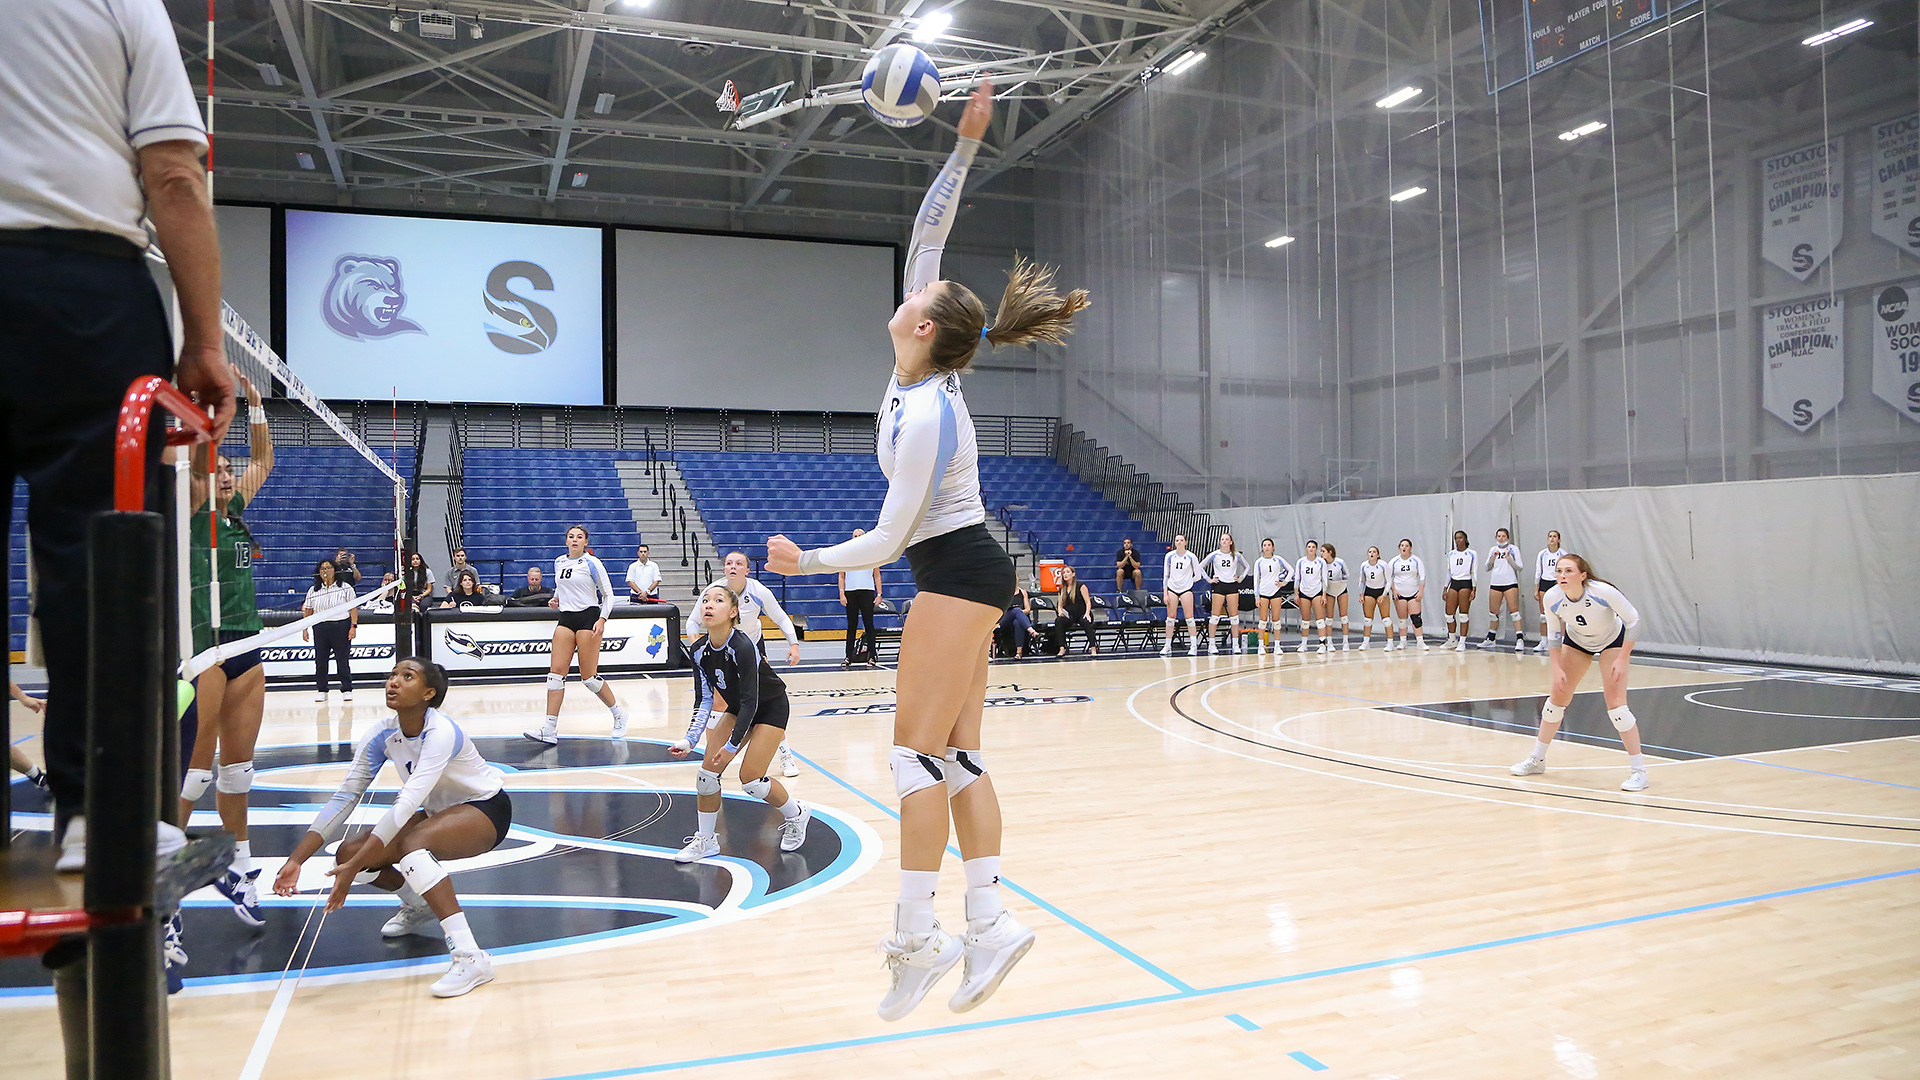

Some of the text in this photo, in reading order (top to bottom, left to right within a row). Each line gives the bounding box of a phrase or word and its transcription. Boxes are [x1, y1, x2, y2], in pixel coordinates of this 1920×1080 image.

[1567, 6, 1590, 23] PLAYER
[1630, 11, 1651, 27] SCORE
[1532, 25, 1550, 40] FOULS
[1579, 34, 1600, 50] MATCH
[1535, 55, 1554, 70] SCORE
[1767, 142, 1838, 173] STOCKTON
[1768, 182, 1840, 212] CHAMPIONS
[1791, 200, 1814, 213] NJAC
[1768, 296, 1838, 320] STOCKTON
[1880, 301, 1909, 314] NCAA
[1776, 323, 1800, 332] TRACK
[1809, 316, 1831, 327] FIELD
[1784, 311, 1822, 324] WOMEN'S
[1780, 325, 1826, 339] CONFERENCE
[1791, 347, 1814, 357] NJAC
[235, 541, 251, 568] 13
[1221, 559, 1231, 567] 22
[1305, 566, 1314, 574] 21
[559, 568, 573, 579] 18
[1575, 614, 1587, 626] 9
[260, 648, 315, 660] OCKTON
[715, 668, 727, 690] 3
